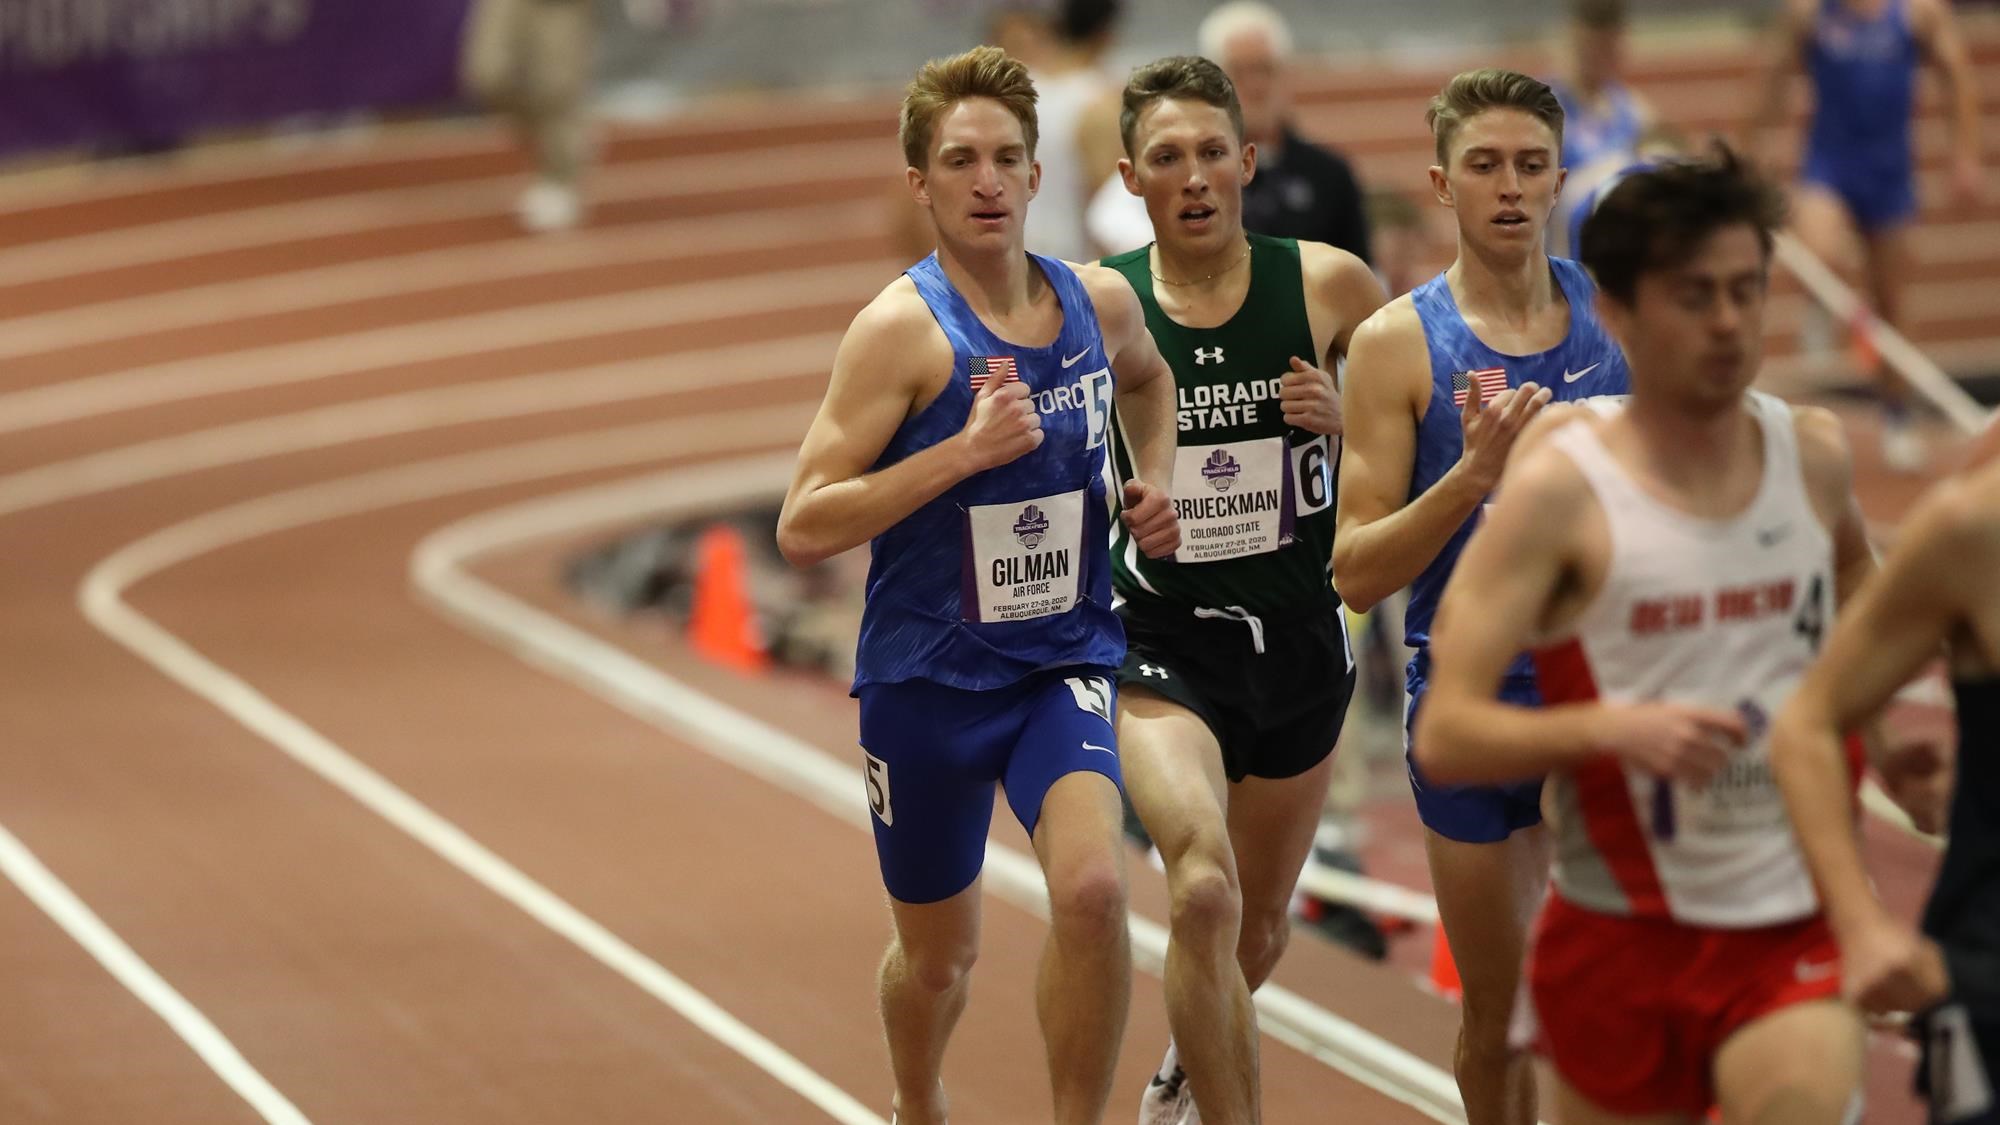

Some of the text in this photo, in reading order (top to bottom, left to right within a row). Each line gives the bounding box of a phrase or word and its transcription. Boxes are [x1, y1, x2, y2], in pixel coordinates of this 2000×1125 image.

[1092, 374, 1108, 444] 5
[1177, 403, 1258, 431] STATE
[1300, 444, 1327, 508] 6
[1172, 489, 1279, 520] BRUECKMAN
[1190, 520, 1261, 540] COLORADO STATE
[1186, 542, 1224, 552] FEBRUARY
[1248, 544, 1260, 552] NM
[992, 548, 1069, 587] GILMAN
[1012, 581, 1051, 598] AIR FORCE
[993, 602, 1030, 613] FEBRUARY
[1051, 596, 1068, 605] 2020
[866, 756, 885, 816] 5
